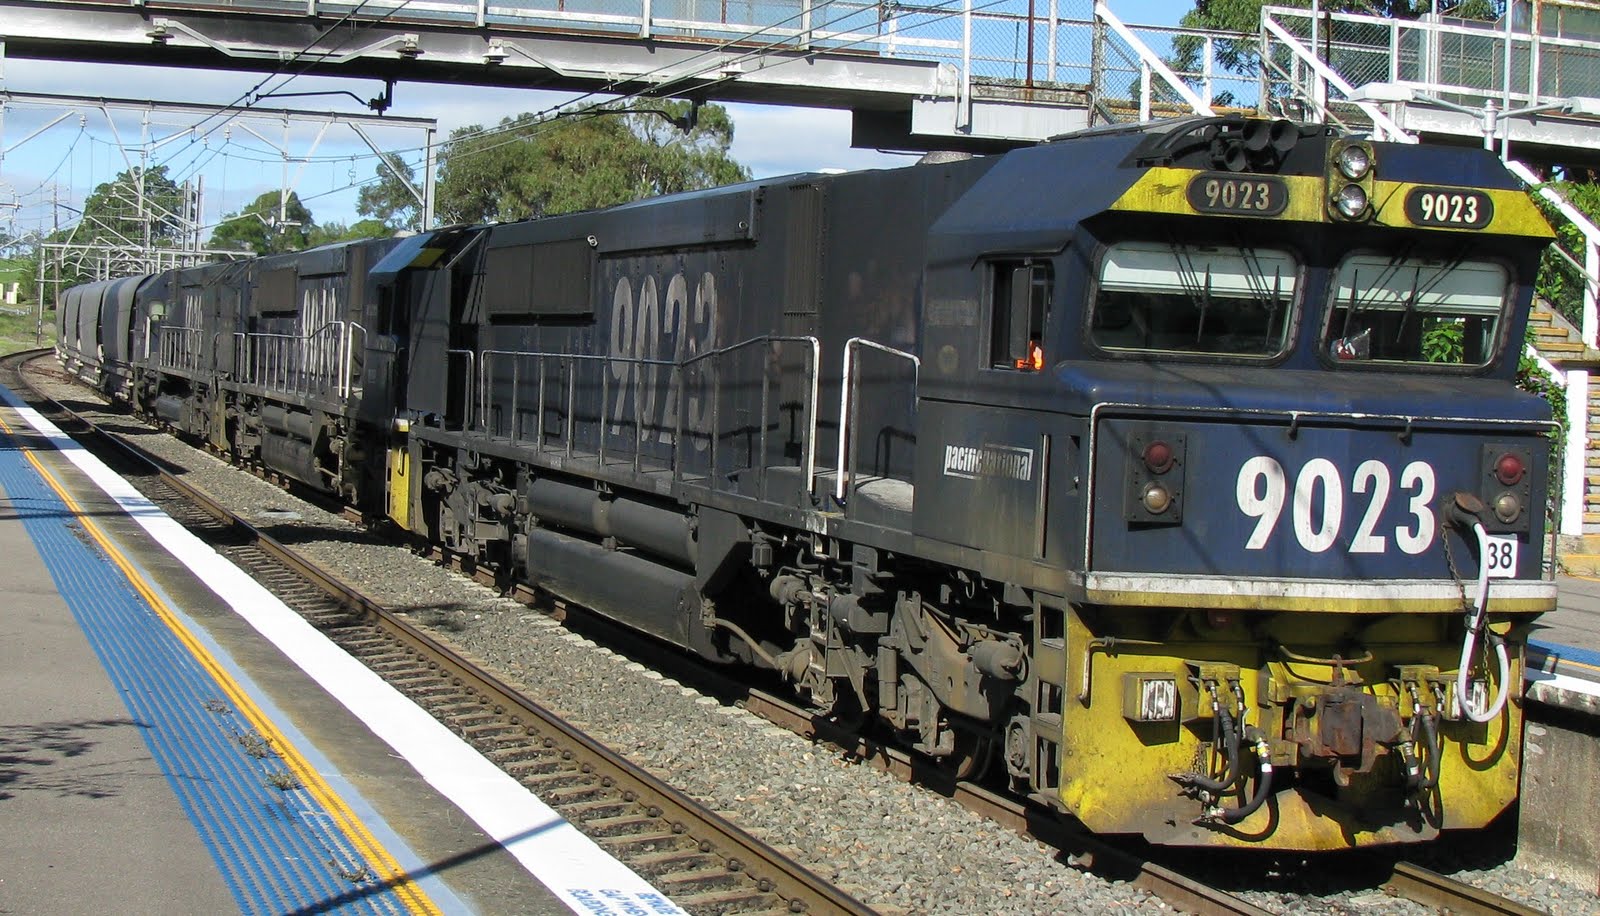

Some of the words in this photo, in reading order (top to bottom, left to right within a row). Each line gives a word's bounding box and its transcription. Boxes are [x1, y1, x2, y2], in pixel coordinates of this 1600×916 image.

[1204, 179, 1270, 210] 9023
[1421, 193, 1479, 224] 9023
[610, 272, 719, 451] 9023
[1236, 455, 1436, 555] 9023
[1487, 542, 1513, 570] 38
